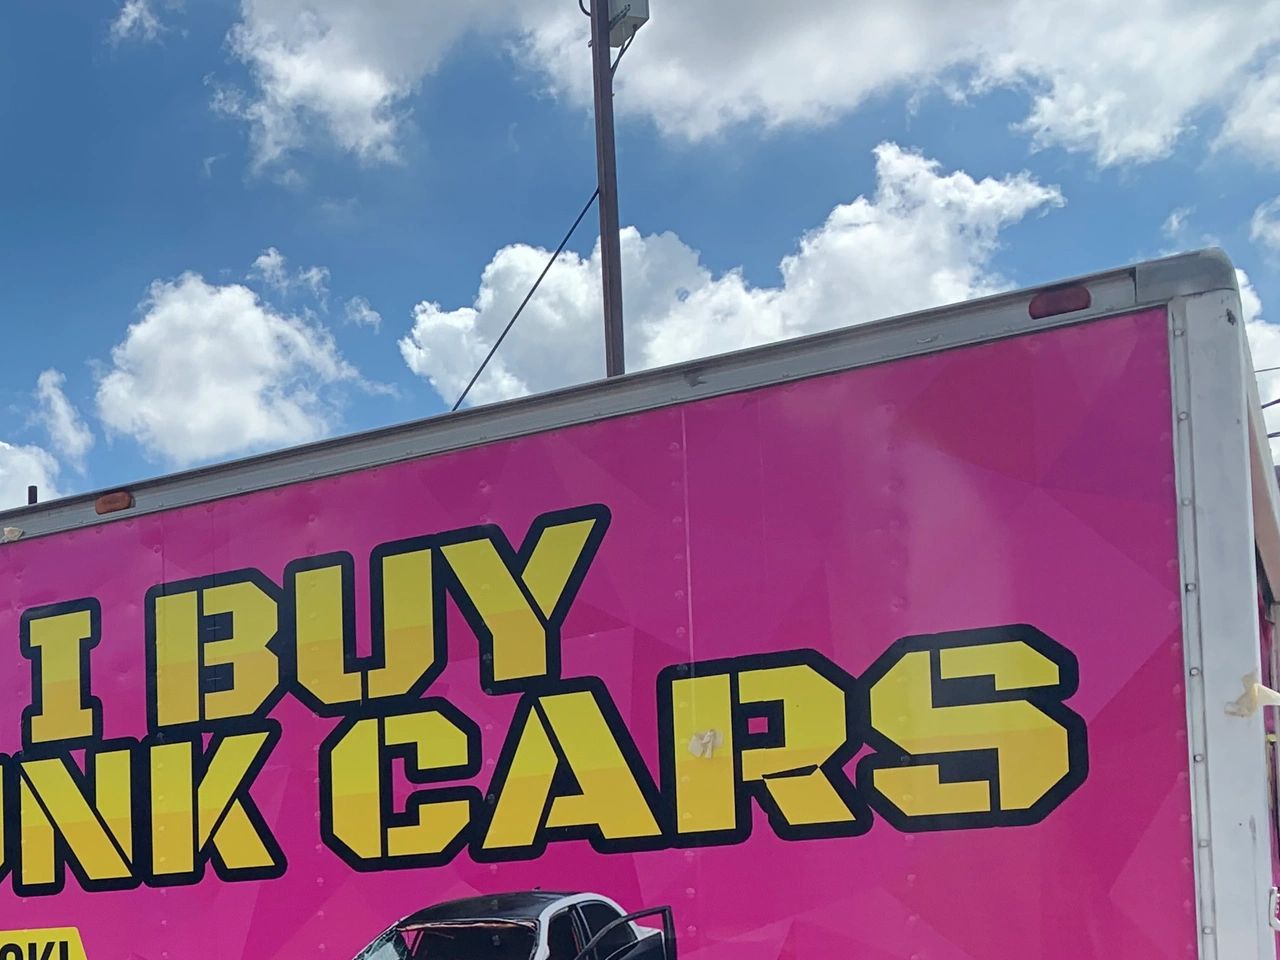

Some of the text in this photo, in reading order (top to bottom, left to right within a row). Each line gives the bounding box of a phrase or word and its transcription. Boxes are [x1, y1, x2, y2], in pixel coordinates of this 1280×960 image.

[22, 504, 611, 753] I BUY
[322, 623, 1089, 874] CARS
